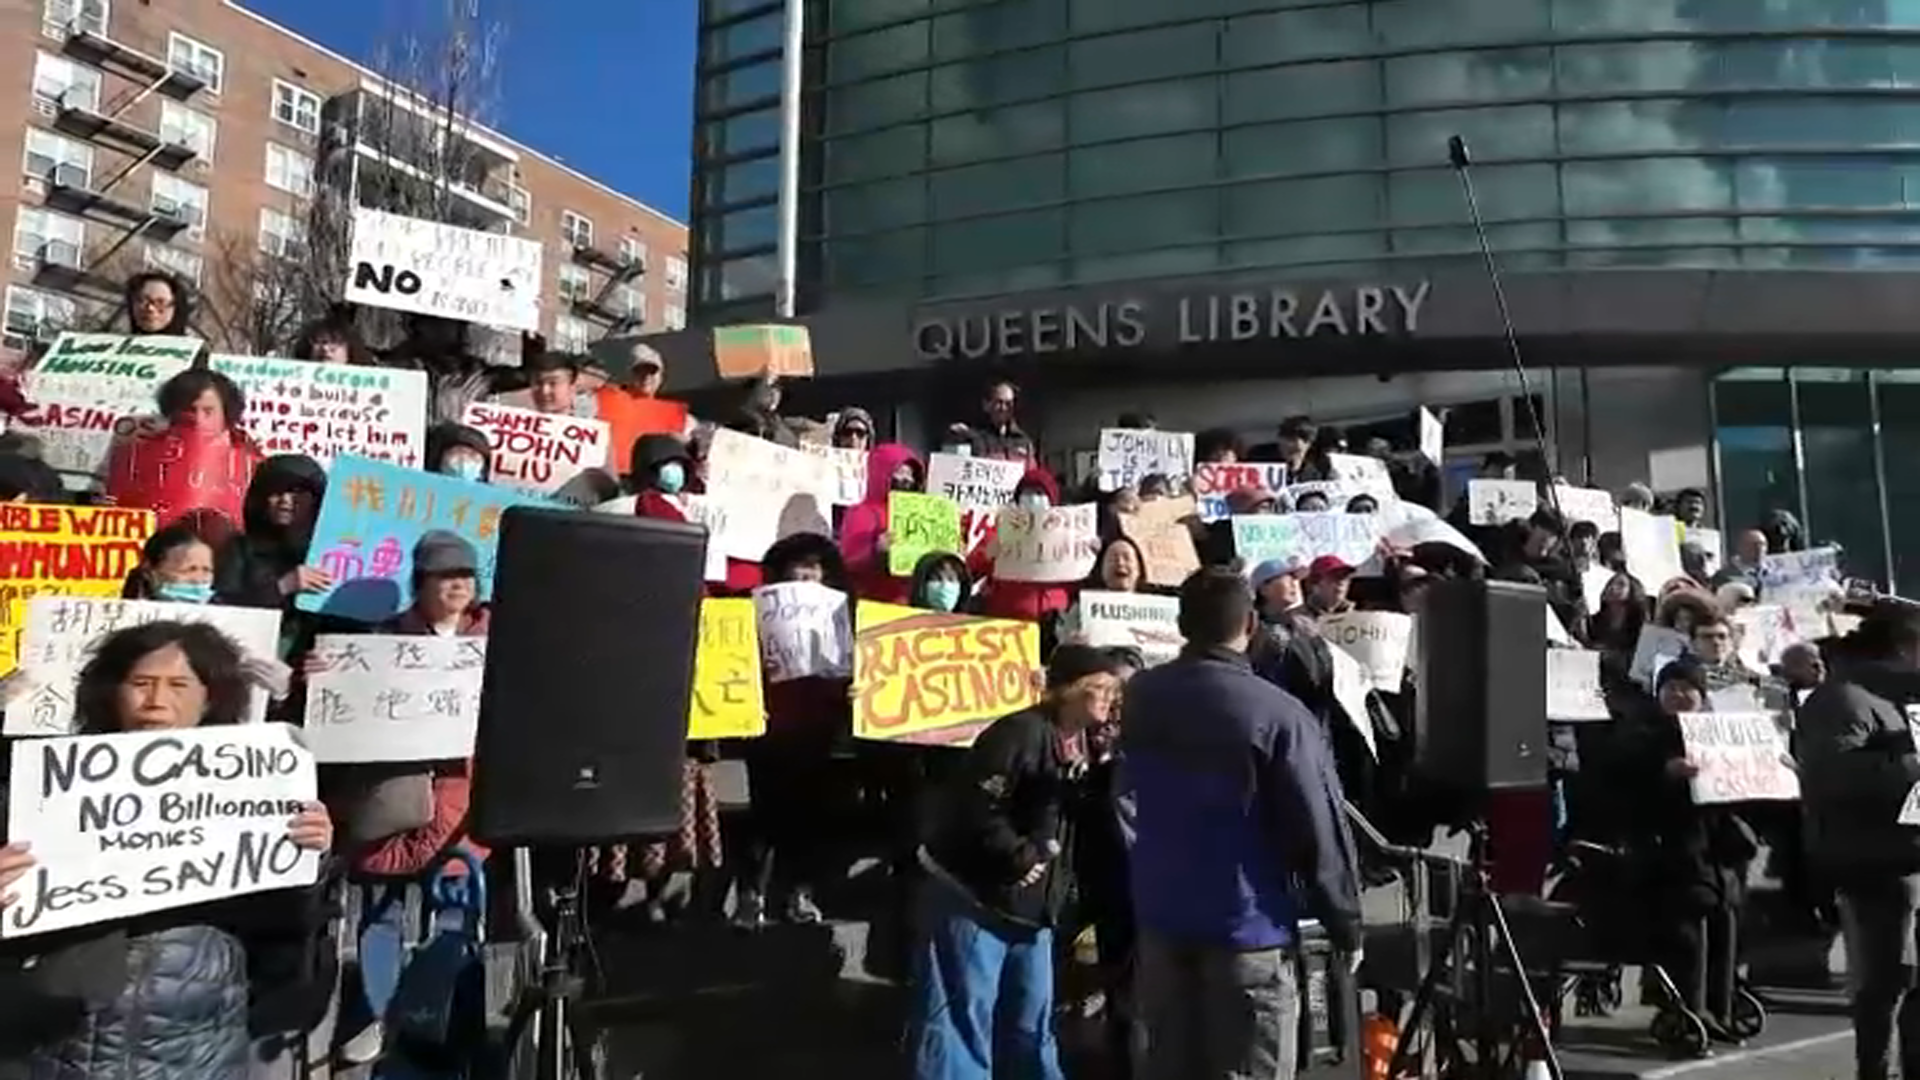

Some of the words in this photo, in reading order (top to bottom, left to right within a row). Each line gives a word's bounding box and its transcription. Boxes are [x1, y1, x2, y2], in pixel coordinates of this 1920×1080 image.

[354, 261, 422, 296] NO
[913, 301, 1146, 361] QUEENS
[1177, 281, 1431, 343] LIBRARY
[273, 381, 302, 398] to
[308, 384, 358, 403] build
[369, 393, 384, 406] a
[327, 422, 357, 441] let
[367, 425, 408, 445] him
[470, 407, 552, 436] SHAME
[563, 425, 599, 445] ON
[489, 429, 581, 464] JOHN
[494, 454, 552, 483] LIU
[66, 509, 147, 538] WITH
[860, 623, 1029, 682] RACIST
[42, 743, 119, 798] NO
[132, 738, 297, 787] CASINO
[79, 793, 142, 833] NO
[12, 867, 128, 929] Jess
[142, 852, 225, 896] SAY
[230, 830, 302, 889] NO
